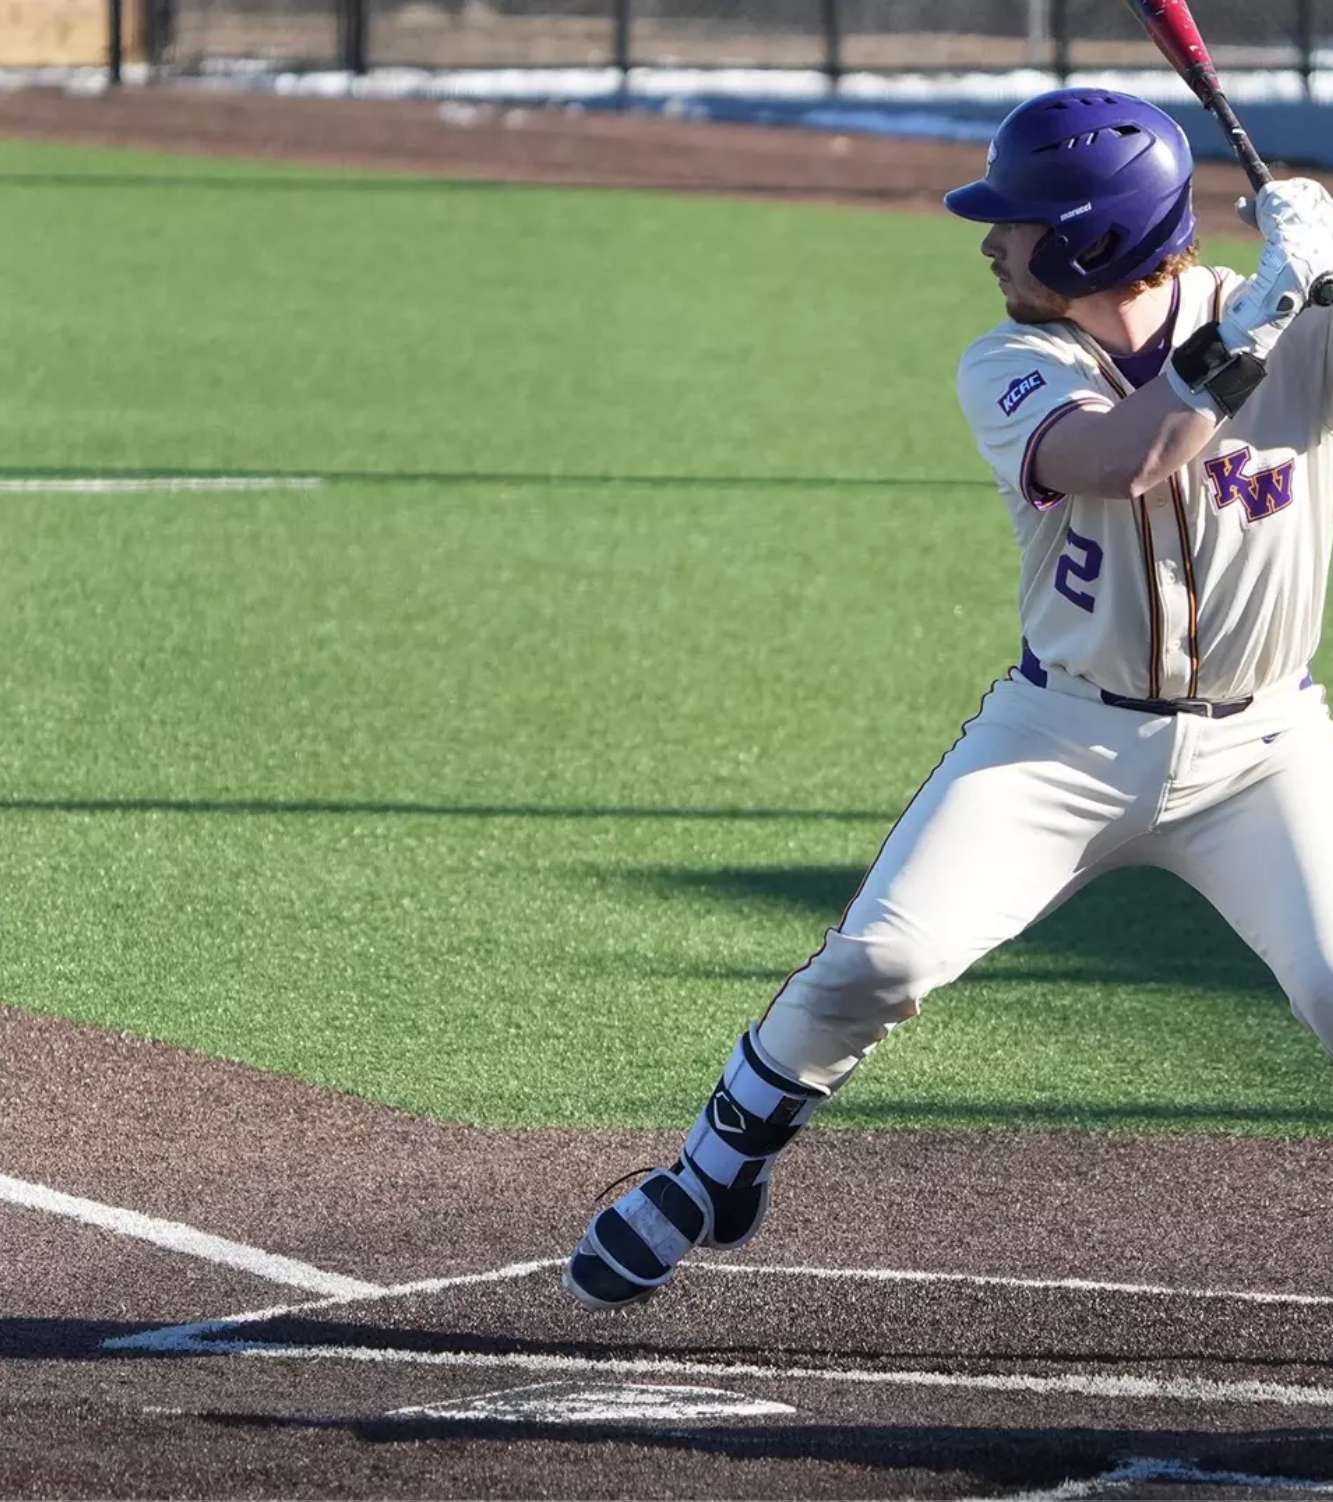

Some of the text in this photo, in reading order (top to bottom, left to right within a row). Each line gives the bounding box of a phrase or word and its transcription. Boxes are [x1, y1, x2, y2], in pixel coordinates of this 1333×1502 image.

[1003, 374, 1041, 412] KCAC
[1203, 446, 1295, 524] KW
[1054, 526, 1103, 613] 2
